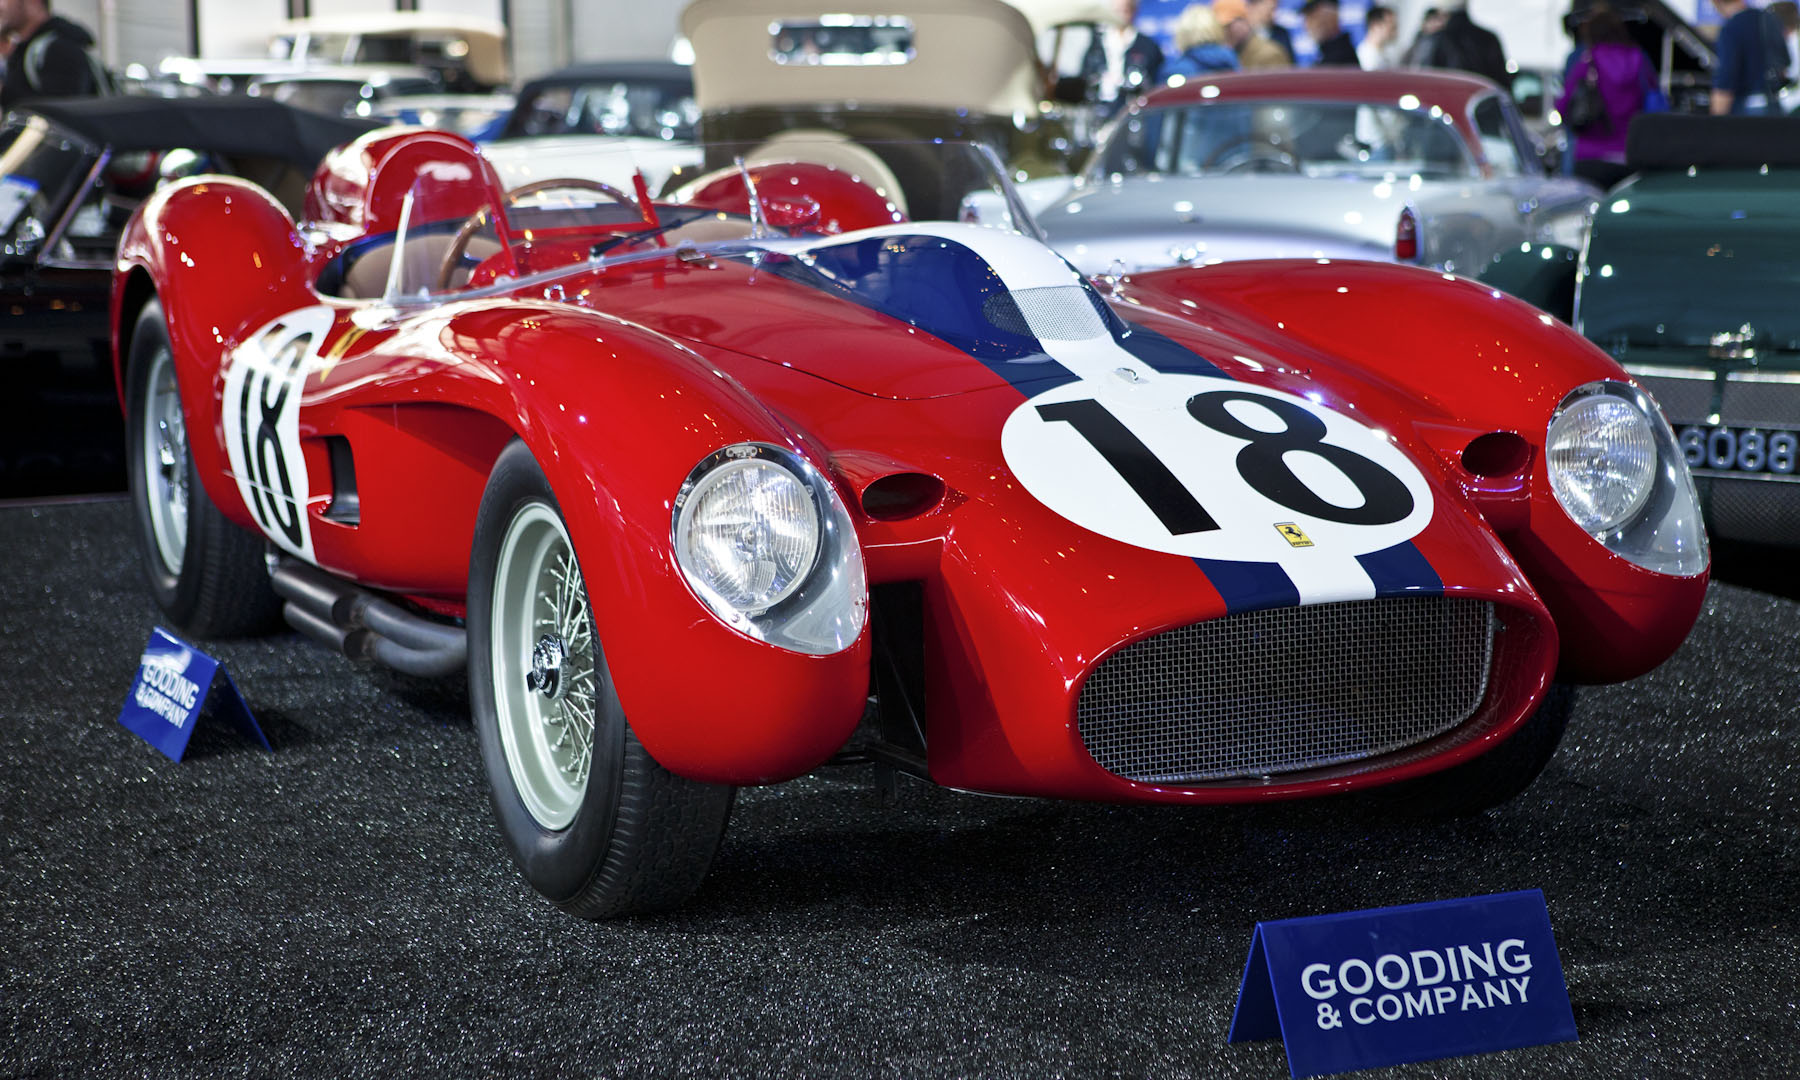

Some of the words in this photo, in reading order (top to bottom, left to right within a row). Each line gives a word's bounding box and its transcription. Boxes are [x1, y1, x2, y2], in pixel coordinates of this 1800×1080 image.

[240, 323, 313, 550] 18
[1034, 390, 1415, 537] 18
[1680, 426, 1797, 473] 6088
[142, 662, 200, 710] GOODING
[143, 686, 190, 729] COMPANY
[1301, 938, 1533, 1000] GOODING
[1317, 1002, 1343, 1031] &
[1349, 976, 1531, 1025] COMPANY
